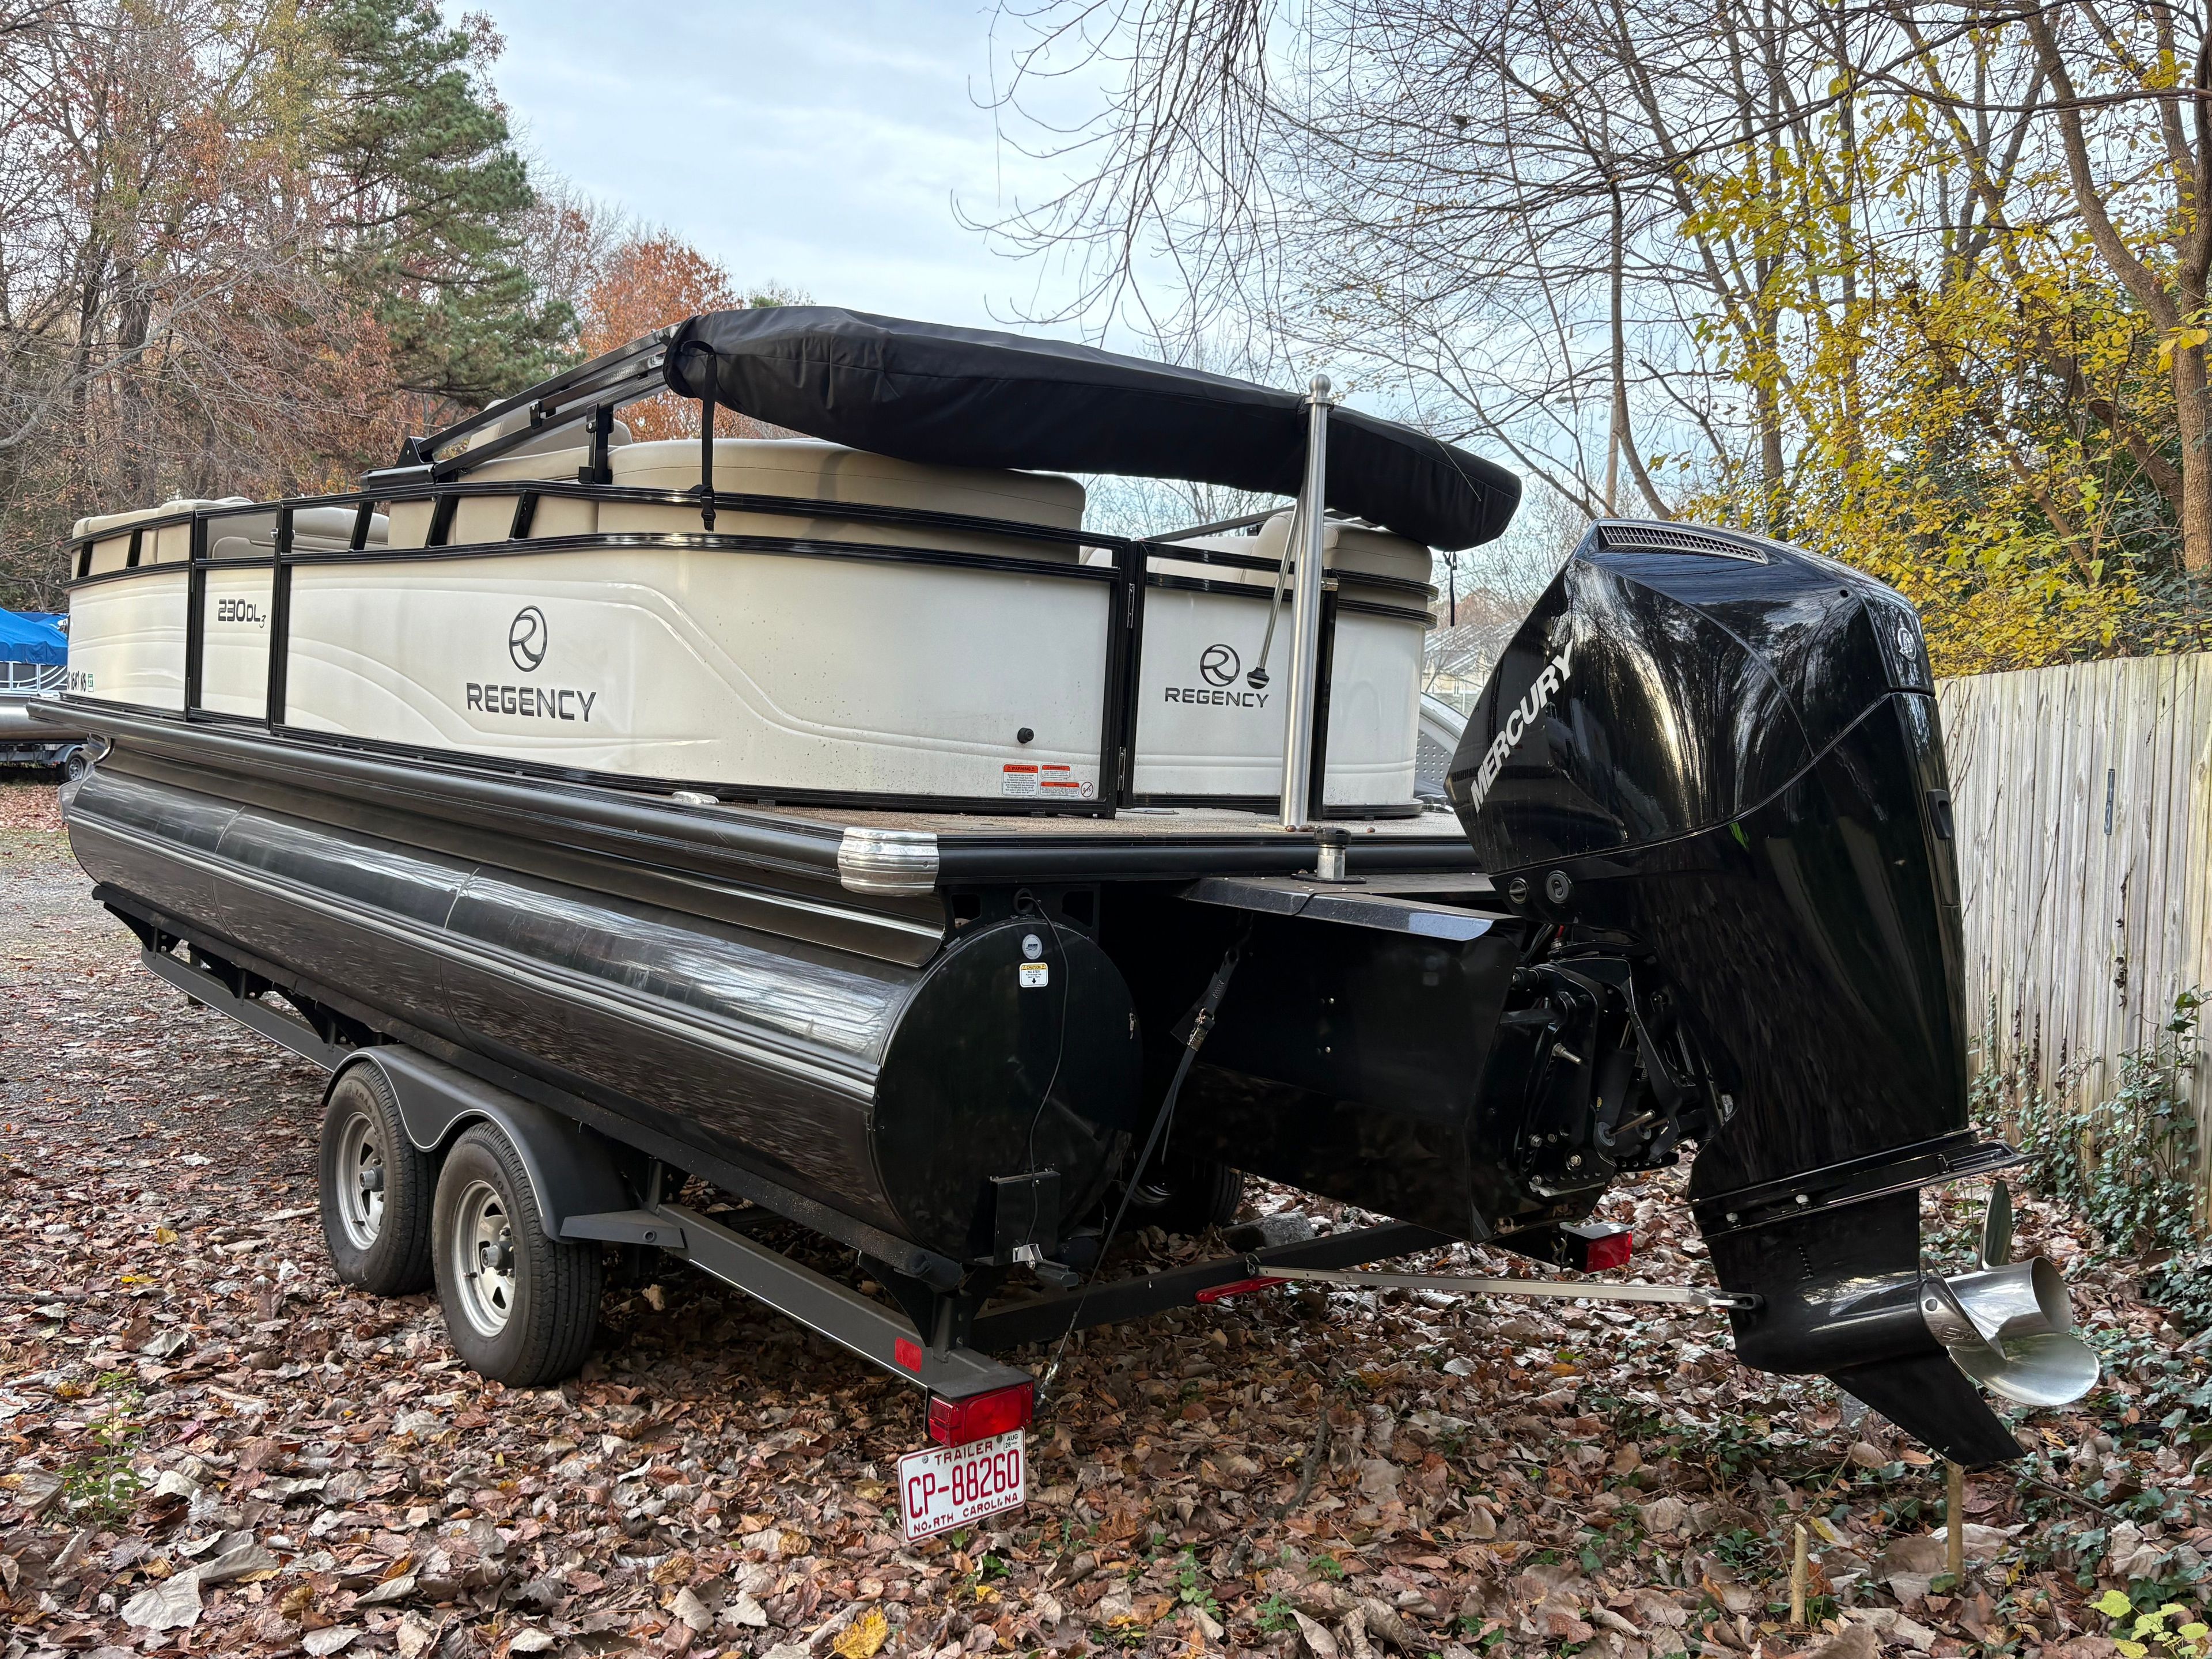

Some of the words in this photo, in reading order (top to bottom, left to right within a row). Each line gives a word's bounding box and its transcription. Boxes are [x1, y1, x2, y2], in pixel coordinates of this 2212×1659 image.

[467, 683, 596, 722] REGENCY
[1165, 687, 1269, 707] REGENCY
[1471, 639, 1573, 814] MERCURY
[934, 1441, 993, 1465] TRAILER
[908, 1449, 1020, 1519] CP-88260
[914, 1513, 953, 1534] NORTH
[963, 1493, 1018, 1517] CAROLINA
